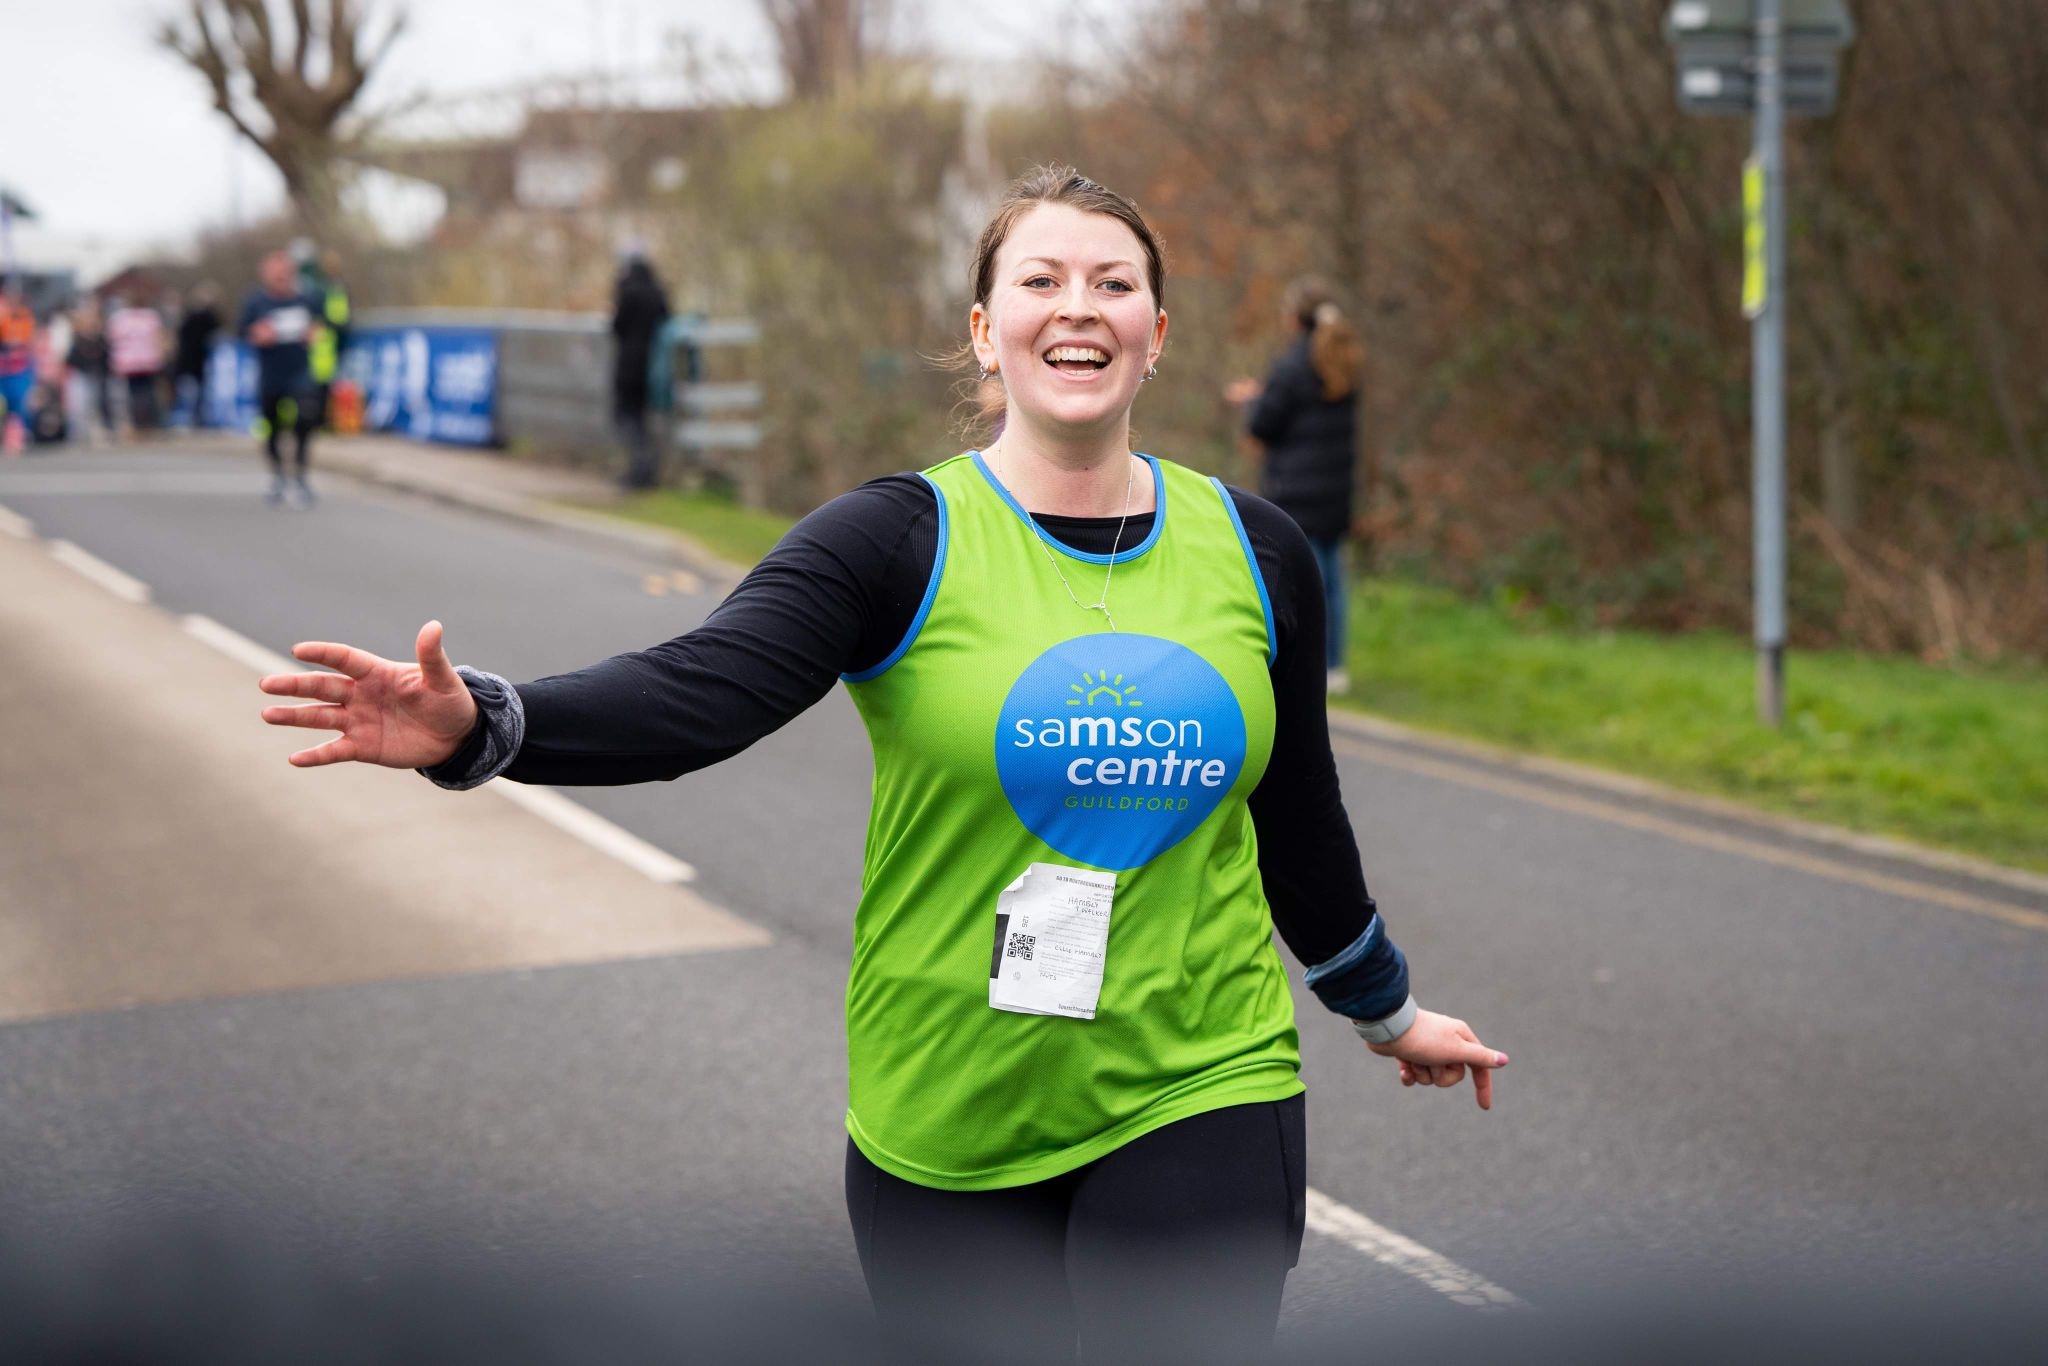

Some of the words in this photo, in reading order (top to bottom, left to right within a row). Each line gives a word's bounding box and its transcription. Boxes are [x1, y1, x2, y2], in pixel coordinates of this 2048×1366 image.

[1014, 716, 1203, 748] samson
[1066, 749, 1226, 787] centre
[1064, 795, 1191, 812] GUILDFORD
